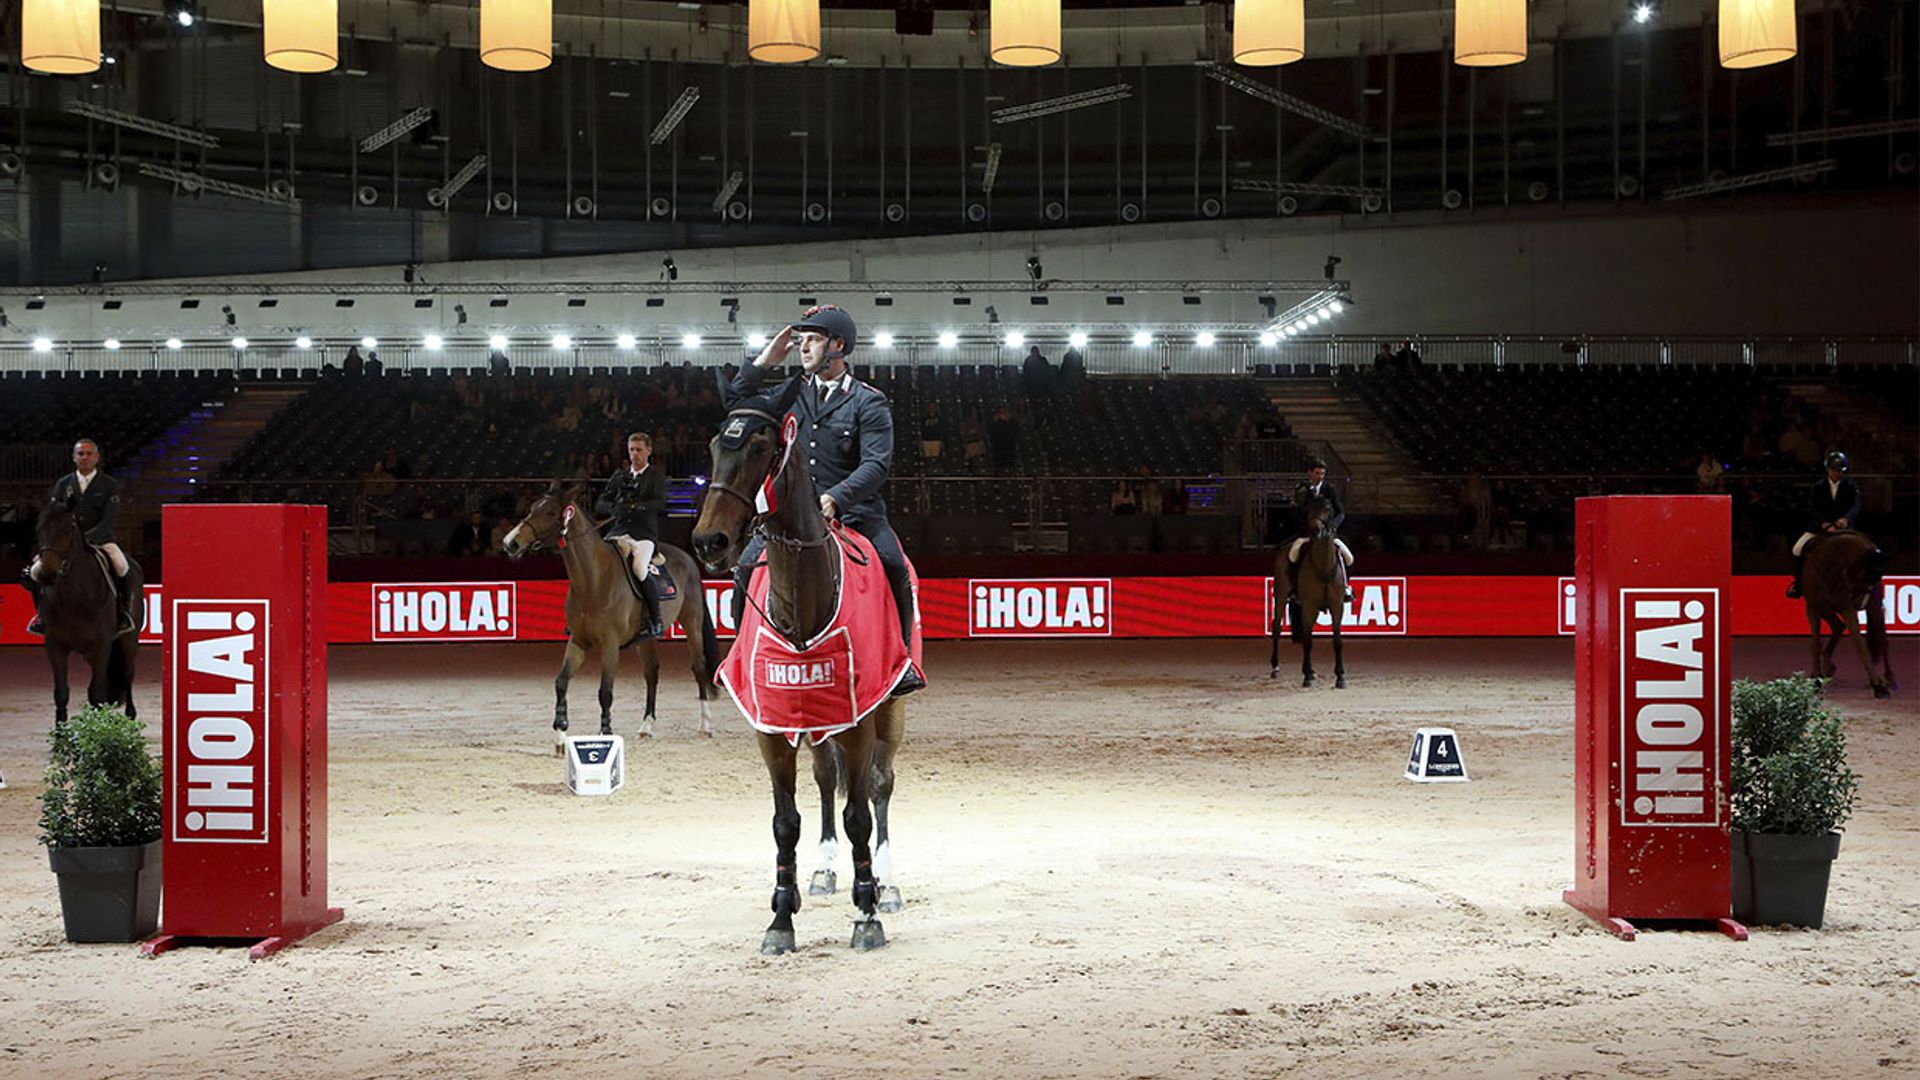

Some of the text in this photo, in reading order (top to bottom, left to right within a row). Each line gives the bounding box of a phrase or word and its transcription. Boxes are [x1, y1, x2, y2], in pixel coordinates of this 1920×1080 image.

[379, 589, 509, 632] ¡HOLA!
[976, 586, 1104, 628] ¡HOLA!
[768, 662, 831, 684] ¡HOLA!
[185, 610, 256, 831] ¡HOLA!
[1634, 599, 1706, 815] ¡HOLA!
[588, 750, 599, 762] 3
[1436, 740, 1449, 758] 4
